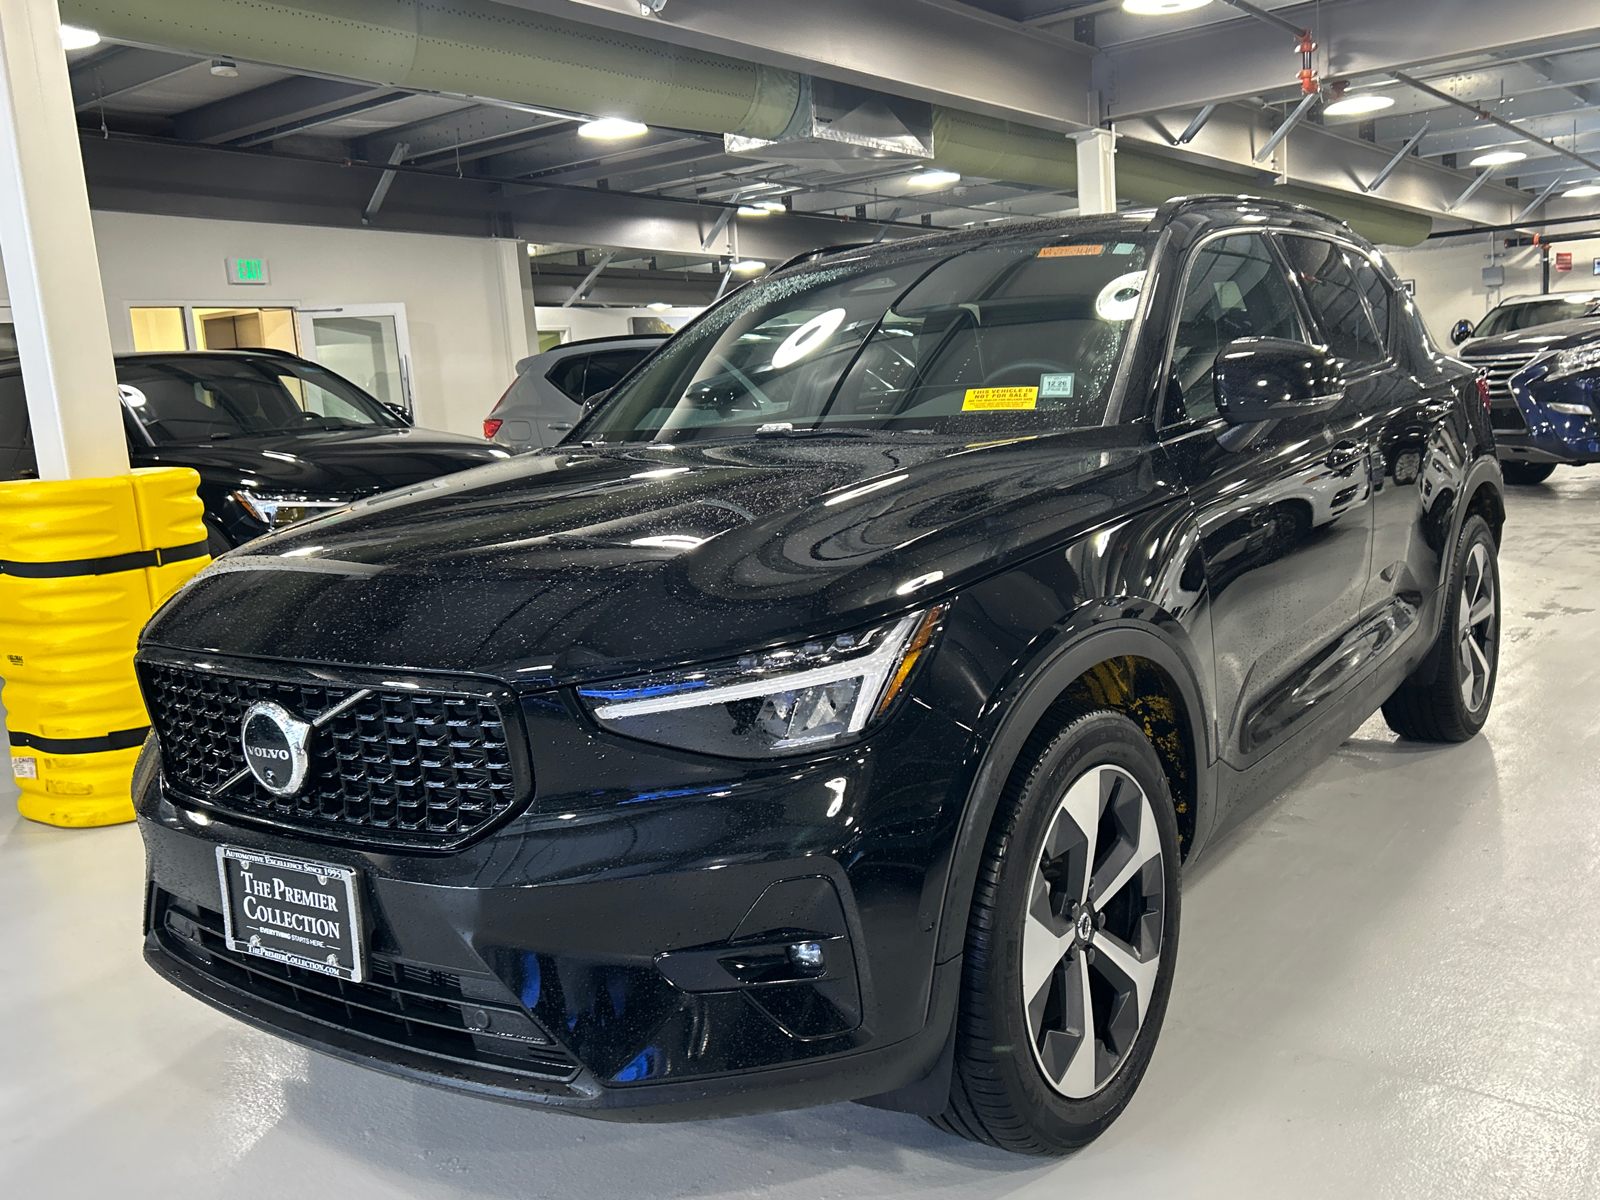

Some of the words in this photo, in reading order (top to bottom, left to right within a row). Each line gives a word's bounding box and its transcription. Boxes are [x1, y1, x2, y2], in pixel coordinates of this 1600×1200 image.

[237, 259, 262, 280] EXIT
[246, 744, 290, 761] VOLVO
[225, 849, 264, 864] AUTOMOTIVE
[264, 855, 303, 872] EXCELLENCE
[303, 863, 324, 875] SINCE
[324, 867, 341, 879] 1995
[240, 871, 272, 899] THE
[272, 877, 339, 912] PREMIER
[243, 896, 340, 940] COLLECTION
[259, 926, 292, 940] EVERYTHING
[292, 934, 310, 945] STARTS
